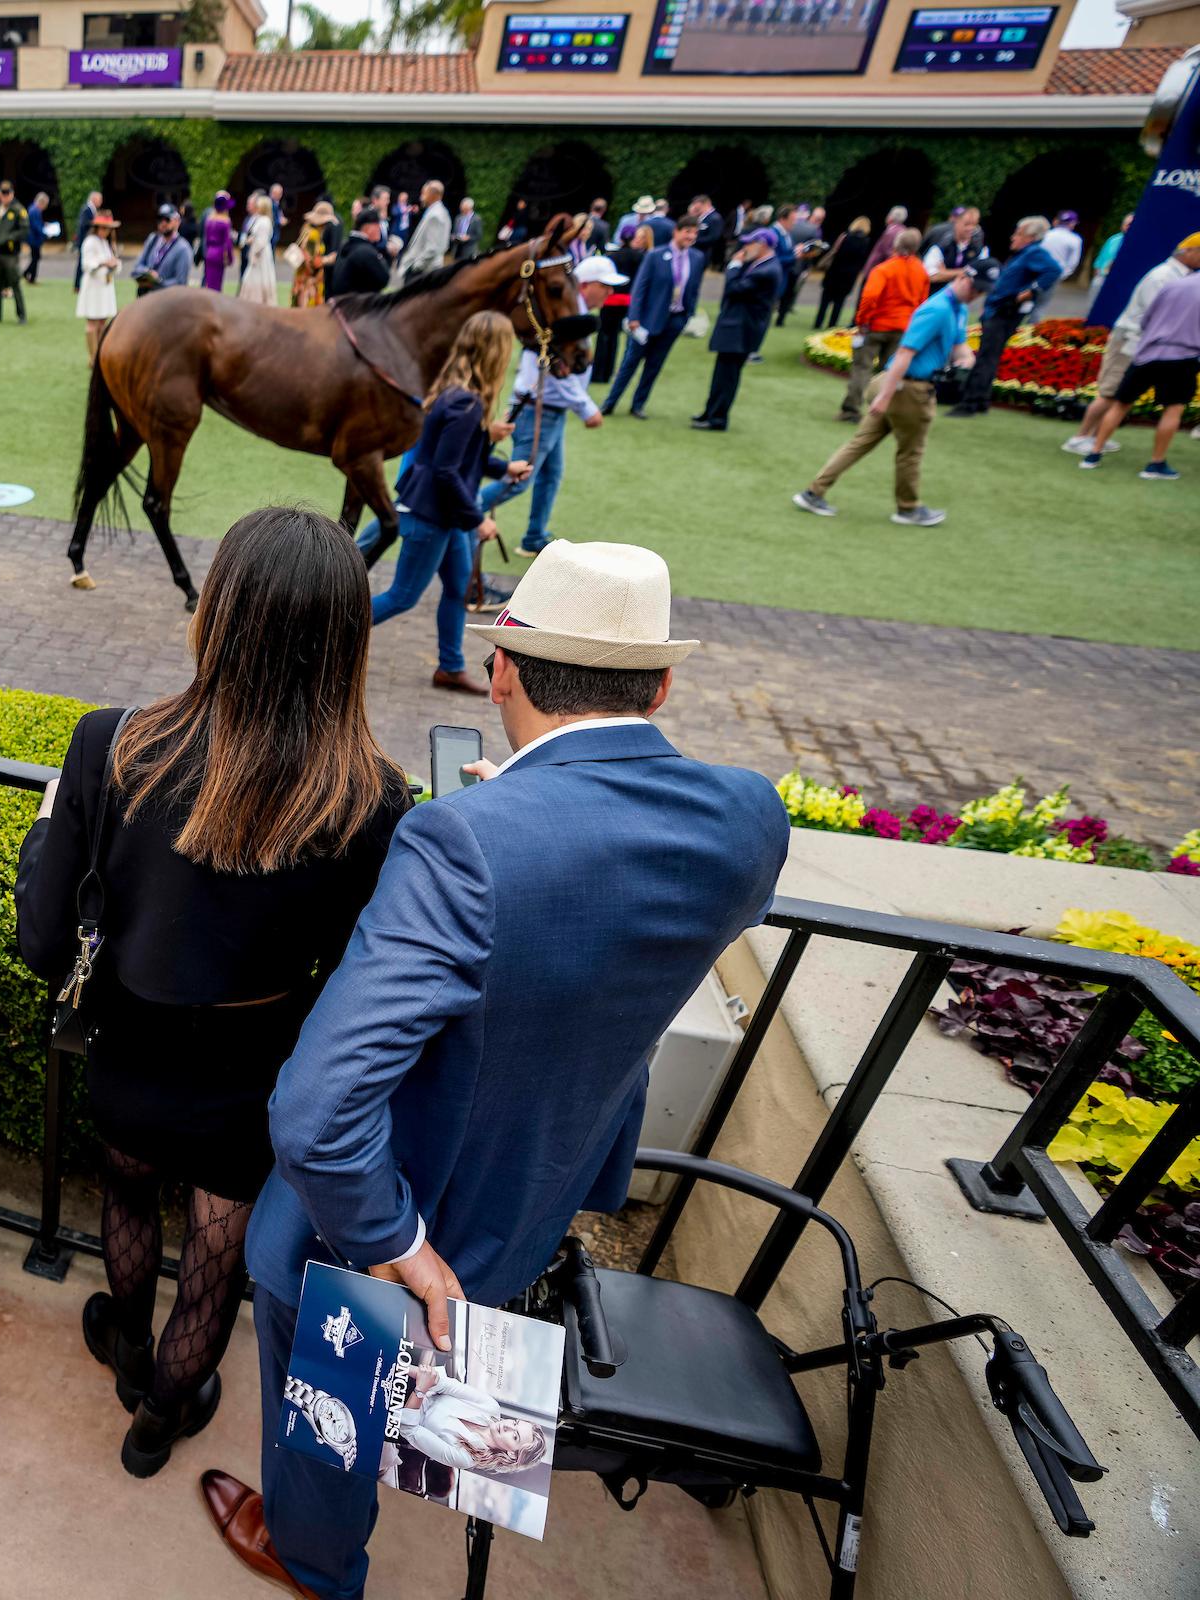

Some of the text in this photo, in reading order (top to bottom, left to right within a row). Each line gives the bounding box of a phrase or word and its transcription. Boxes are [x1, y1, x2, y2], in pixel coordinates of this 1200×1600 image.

[80, 52, 169, 73] LONGINES
[369, 1357, 383, 1408] Official Timekeeper
[384, 1338, 414, 1440] LONGINES
